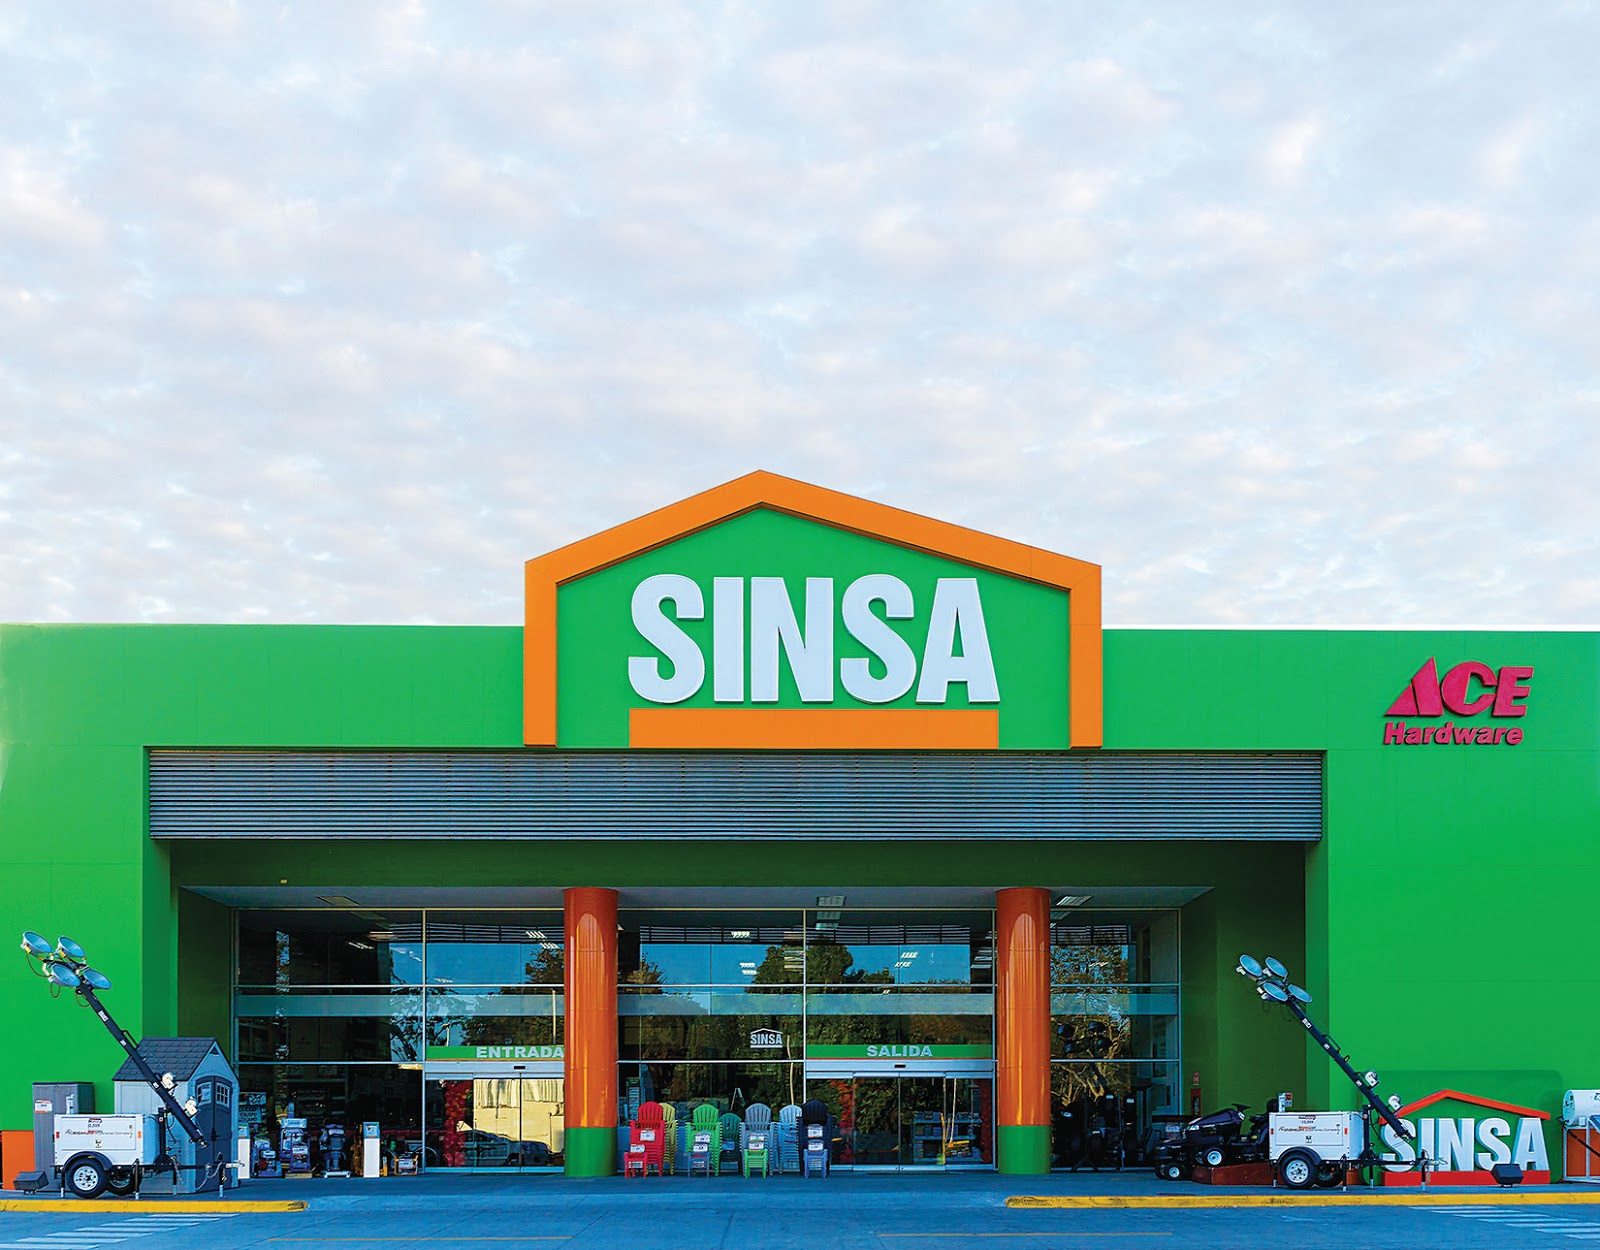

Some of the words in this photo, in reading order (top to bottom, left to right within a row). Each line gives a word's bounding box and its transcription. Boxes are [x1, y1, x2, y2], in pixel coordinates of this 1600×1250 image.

[628, 573, 1001, 704] SINSA
[1384, 656, 1534, 717] ACE
[1383, 721, 1523, 745] Hardware
[750, 1033, 783, 1045] SINSA
[866, 1045, 933, 1057] SALIDA
[476, 1046, 565, 1058] ENTRADA
[1380, 1117, 1550, 1173] SINSA
